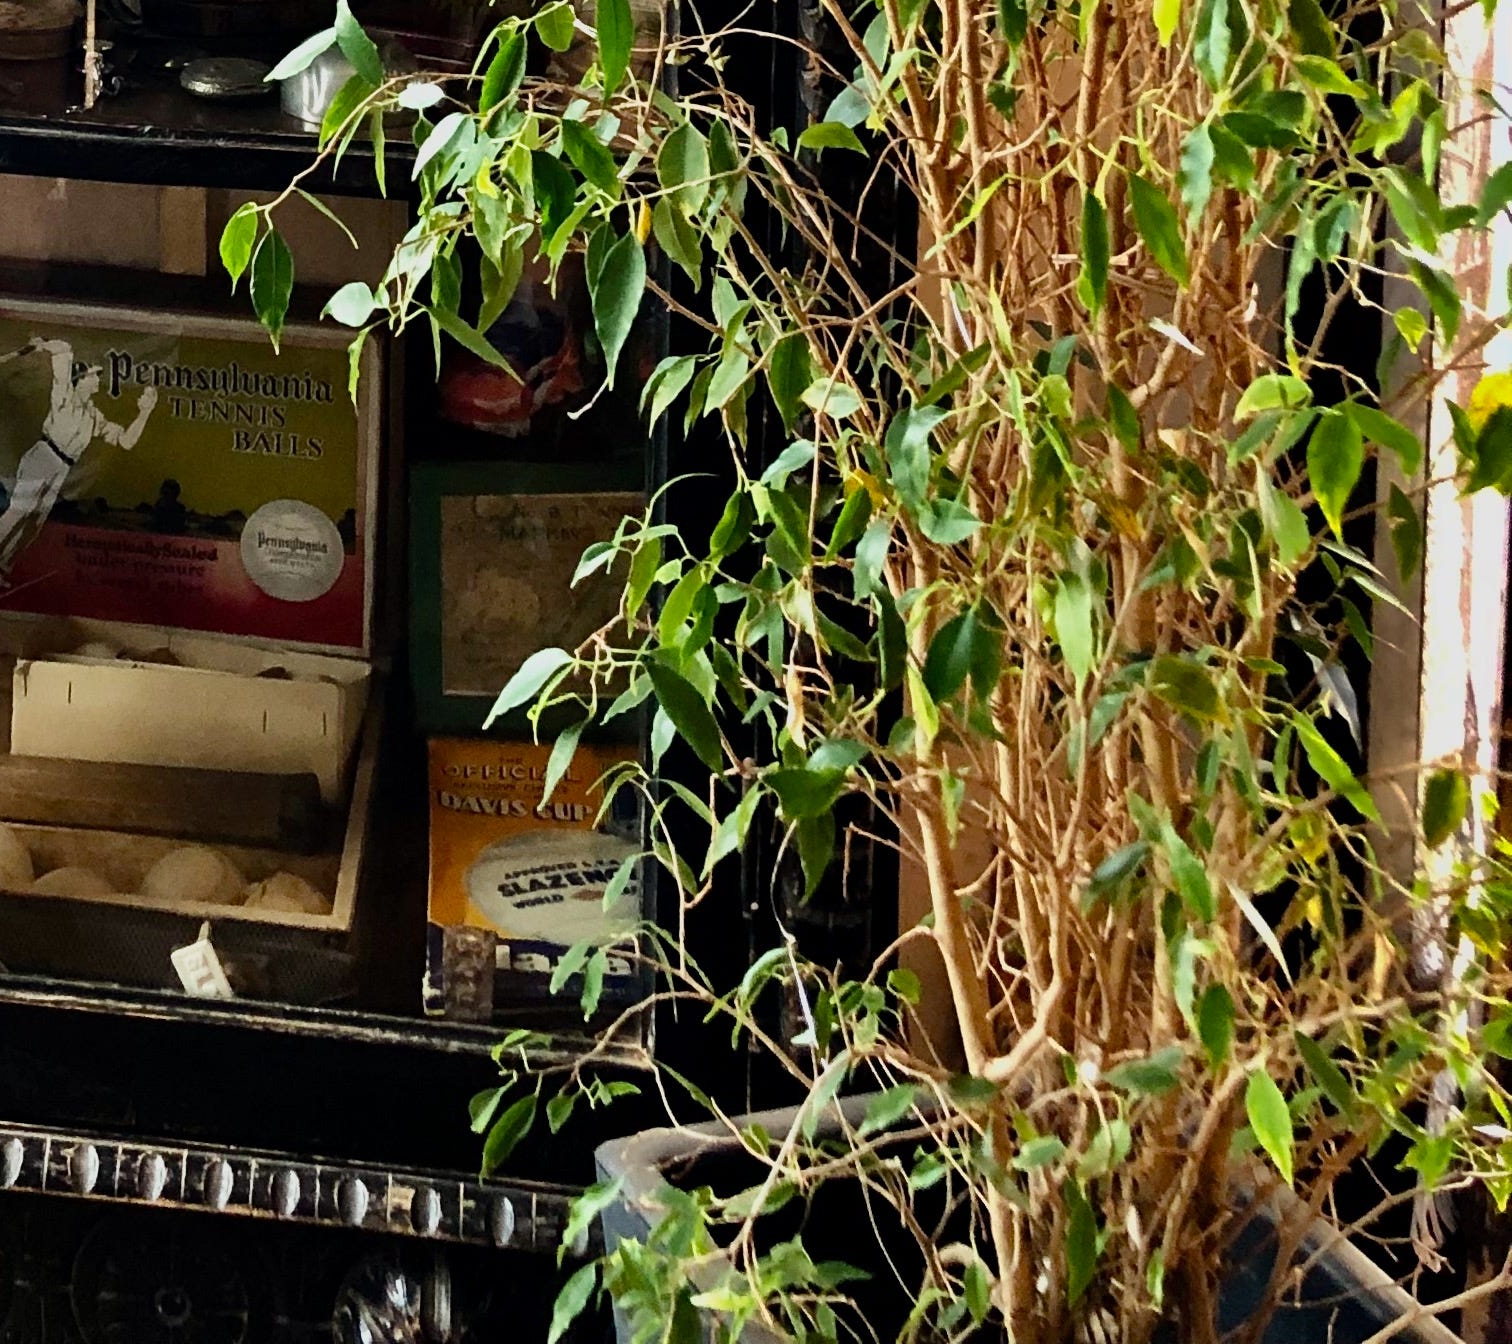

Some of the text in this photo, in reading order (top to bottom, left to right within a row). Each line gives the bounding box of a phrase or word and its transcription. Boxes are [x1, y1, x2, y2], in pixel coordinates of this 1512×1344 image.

[106, 347, 335, 405] Pennsylvania
[168, 395, 288, 429] TENNIS
[232, 427, 324, 460] BALLS
[440, 764, 581, 784] OFFICIL
[437, 790, 528, 817] DAVIS
